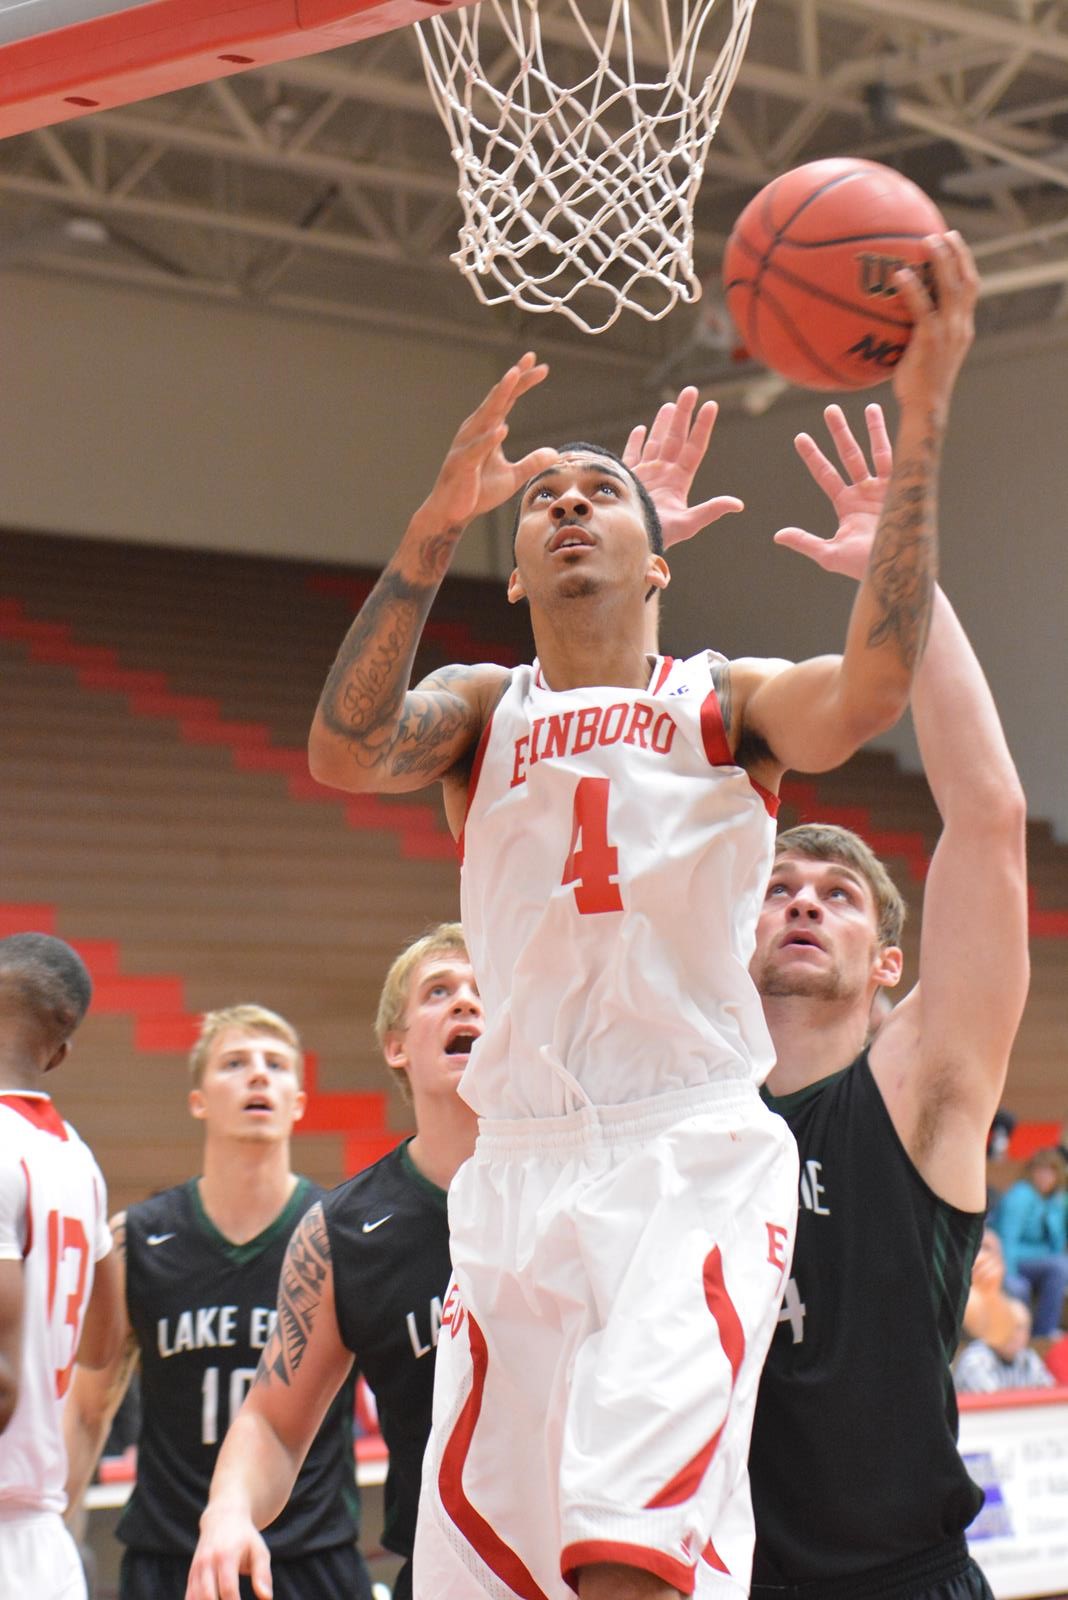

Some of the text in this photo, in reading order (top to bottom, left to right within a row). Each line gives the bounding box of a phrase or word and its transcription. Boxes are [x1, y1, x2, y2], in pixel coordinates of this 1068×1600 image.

[561, 777, 624, 914] 4
[47, 1210, 90, 1400] 13
[157, 1305, 240, 1359] LAKE
